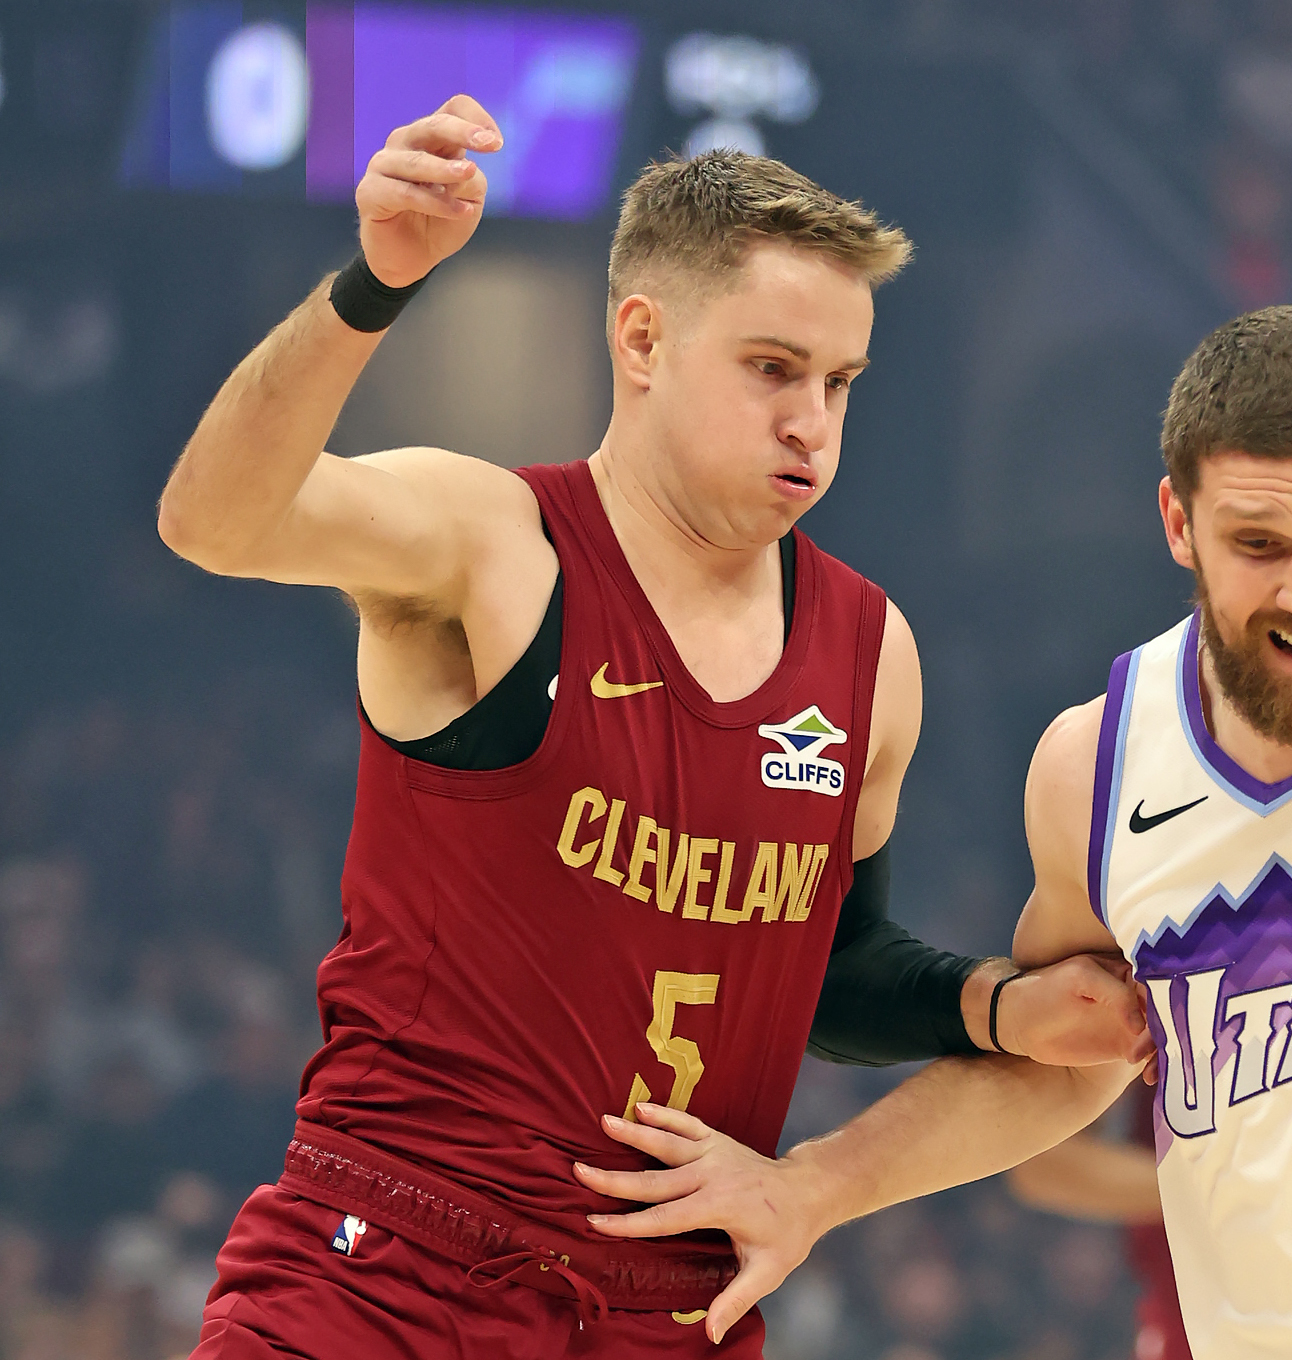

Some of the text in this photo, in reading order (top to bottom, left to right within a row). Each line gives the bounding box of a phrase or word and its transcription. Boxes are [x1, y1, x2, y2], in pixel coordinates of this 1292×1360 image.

[764, 760, 843, 790] CLIFFS
[556, 786, 829, 925] CLEVELAND
[622, 970, 720, 1118] 5
